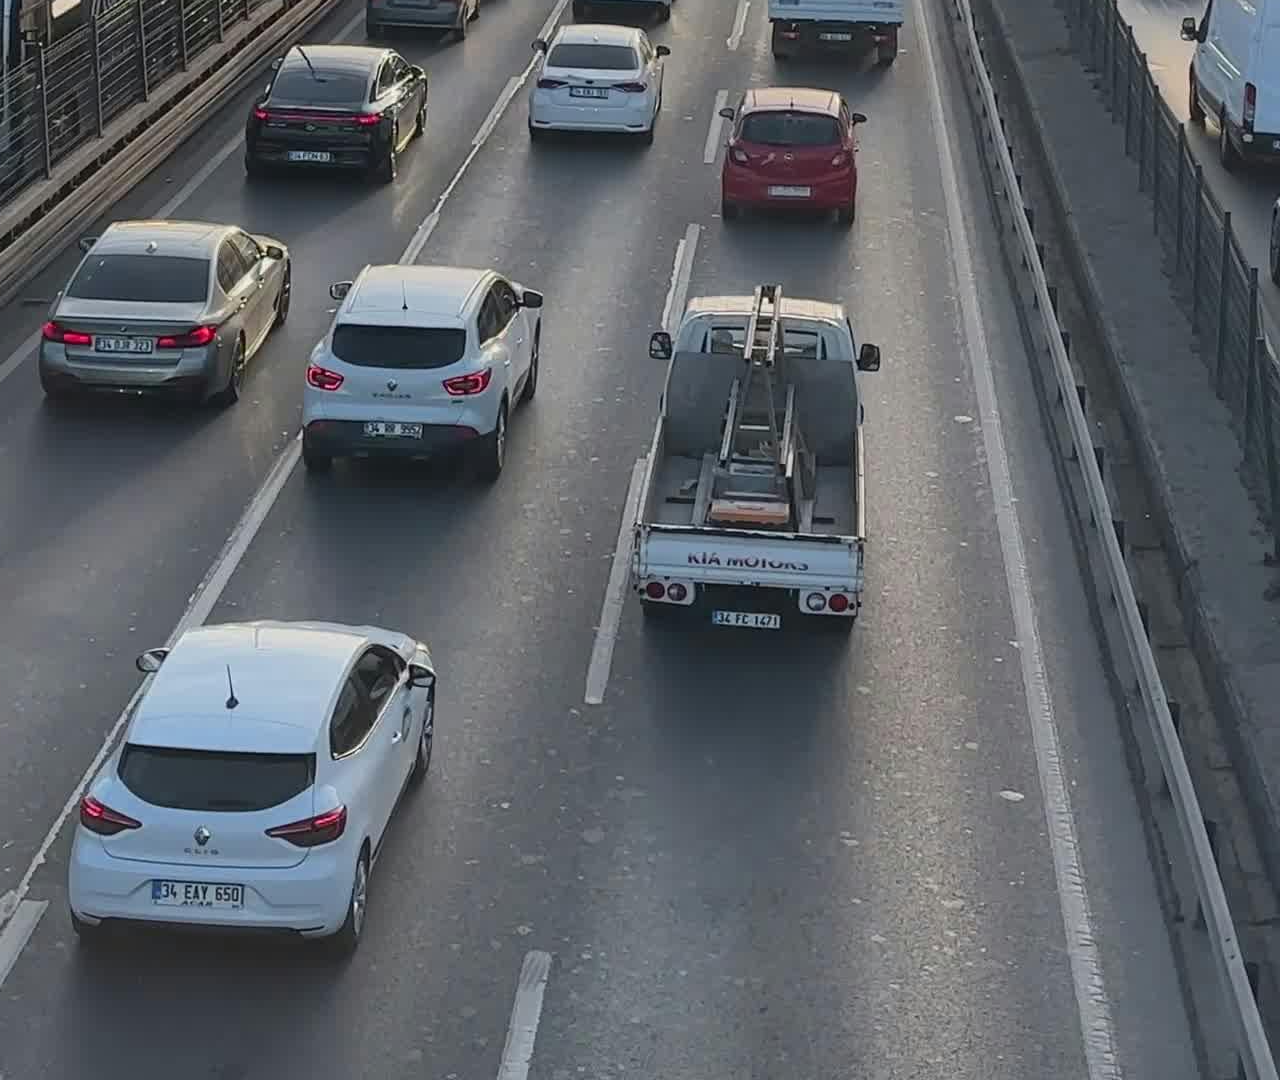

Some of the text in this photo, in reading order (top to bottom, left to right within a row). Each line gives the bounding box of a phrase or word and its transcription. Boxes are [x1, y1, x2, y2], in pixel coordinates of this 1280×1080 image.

[719, 612, 732, 624] 34
[754, 615, 778, 628] 1471
[162, 883, 240, 902] 34 EAY 650
